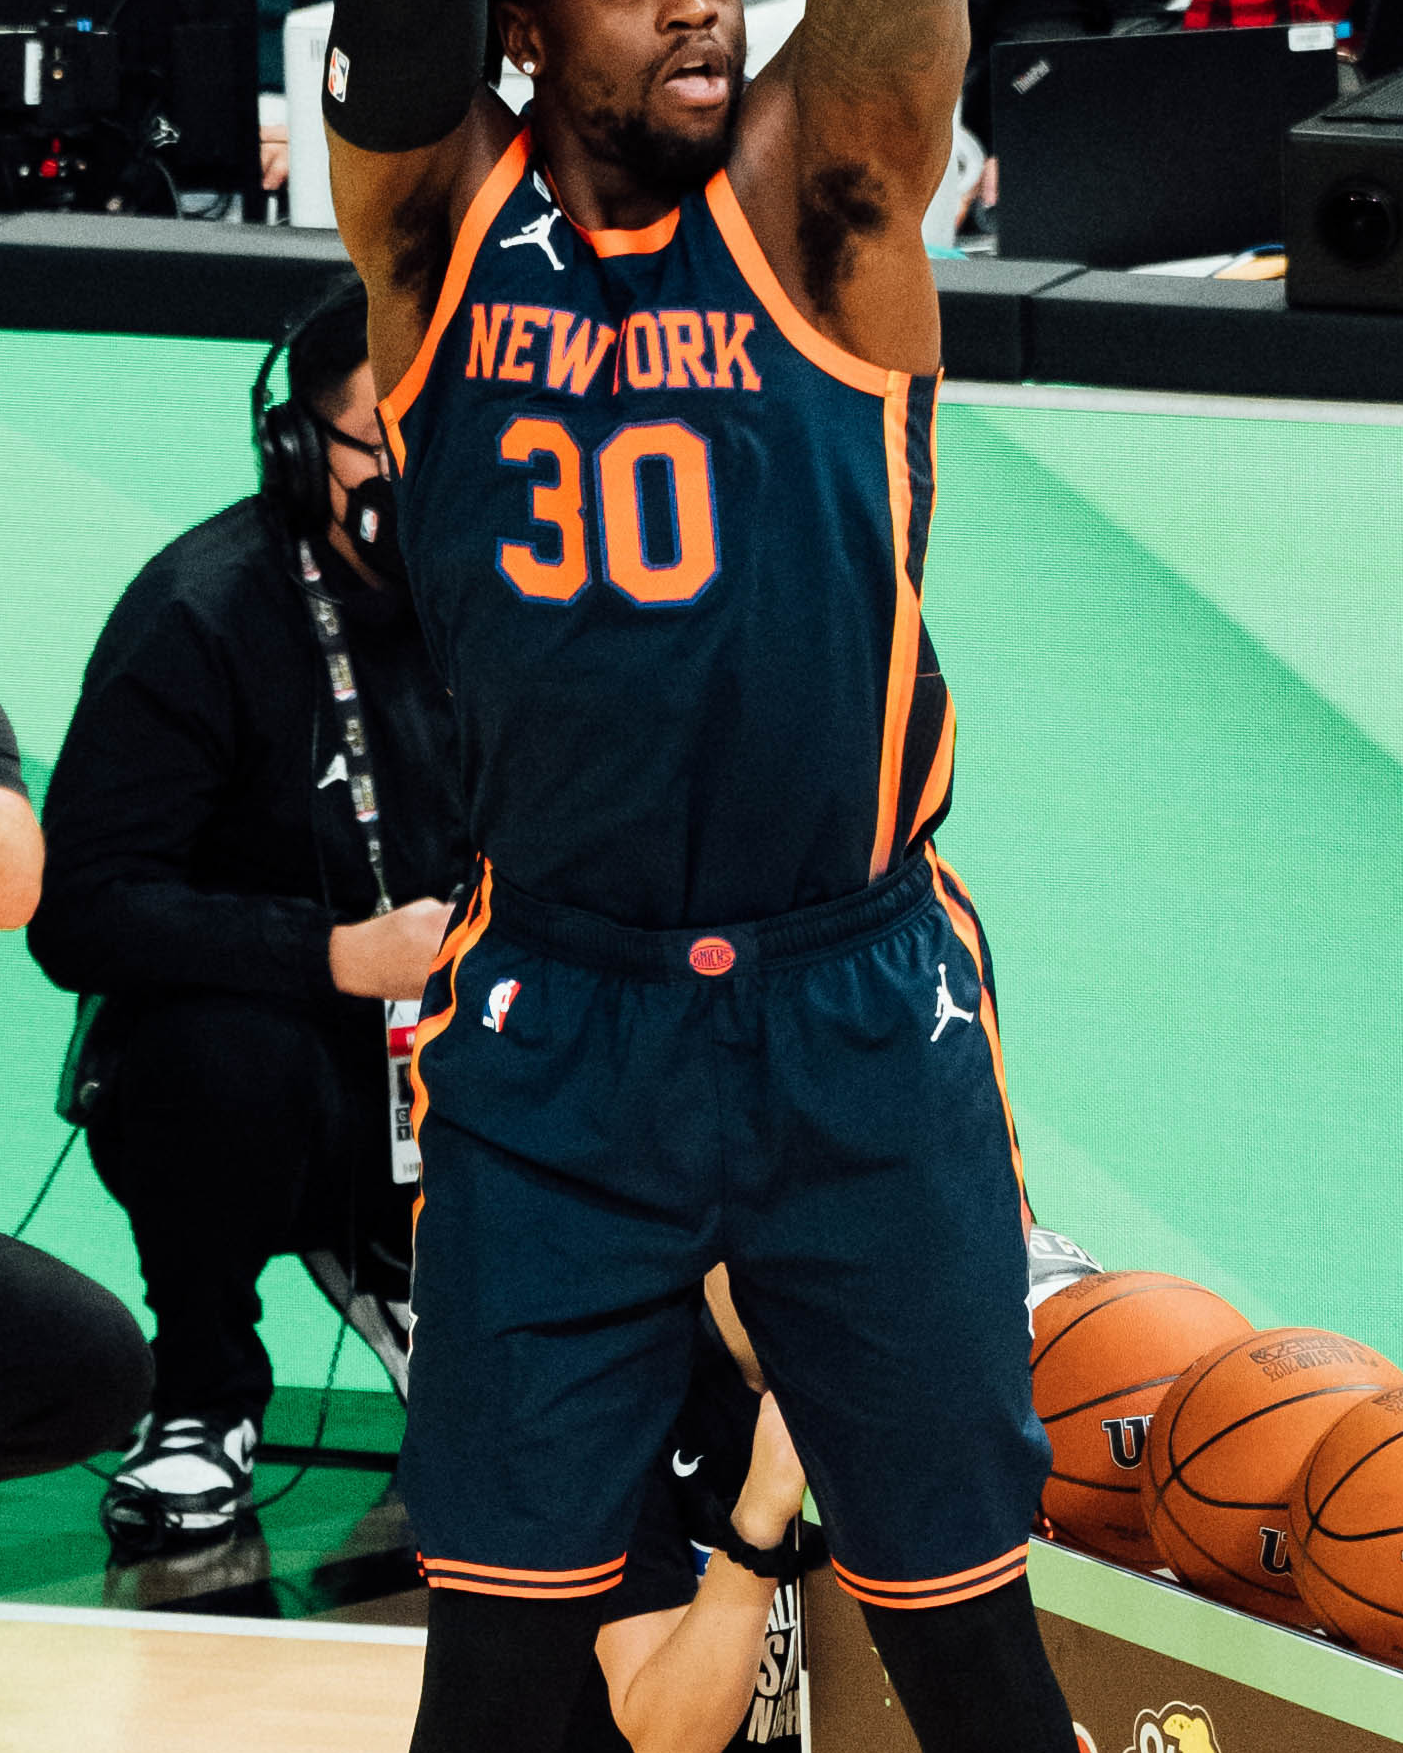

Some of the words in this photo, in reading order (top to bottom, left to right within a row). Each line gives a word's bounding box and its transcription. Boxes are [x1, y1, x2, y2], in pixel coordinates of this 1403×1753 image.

[464, 302, 617, 397] NEW
[612, 309, 762, 398] ORK
[496, 414, 723, 608] 30
[691, 947, 733, 968] KNICKS
